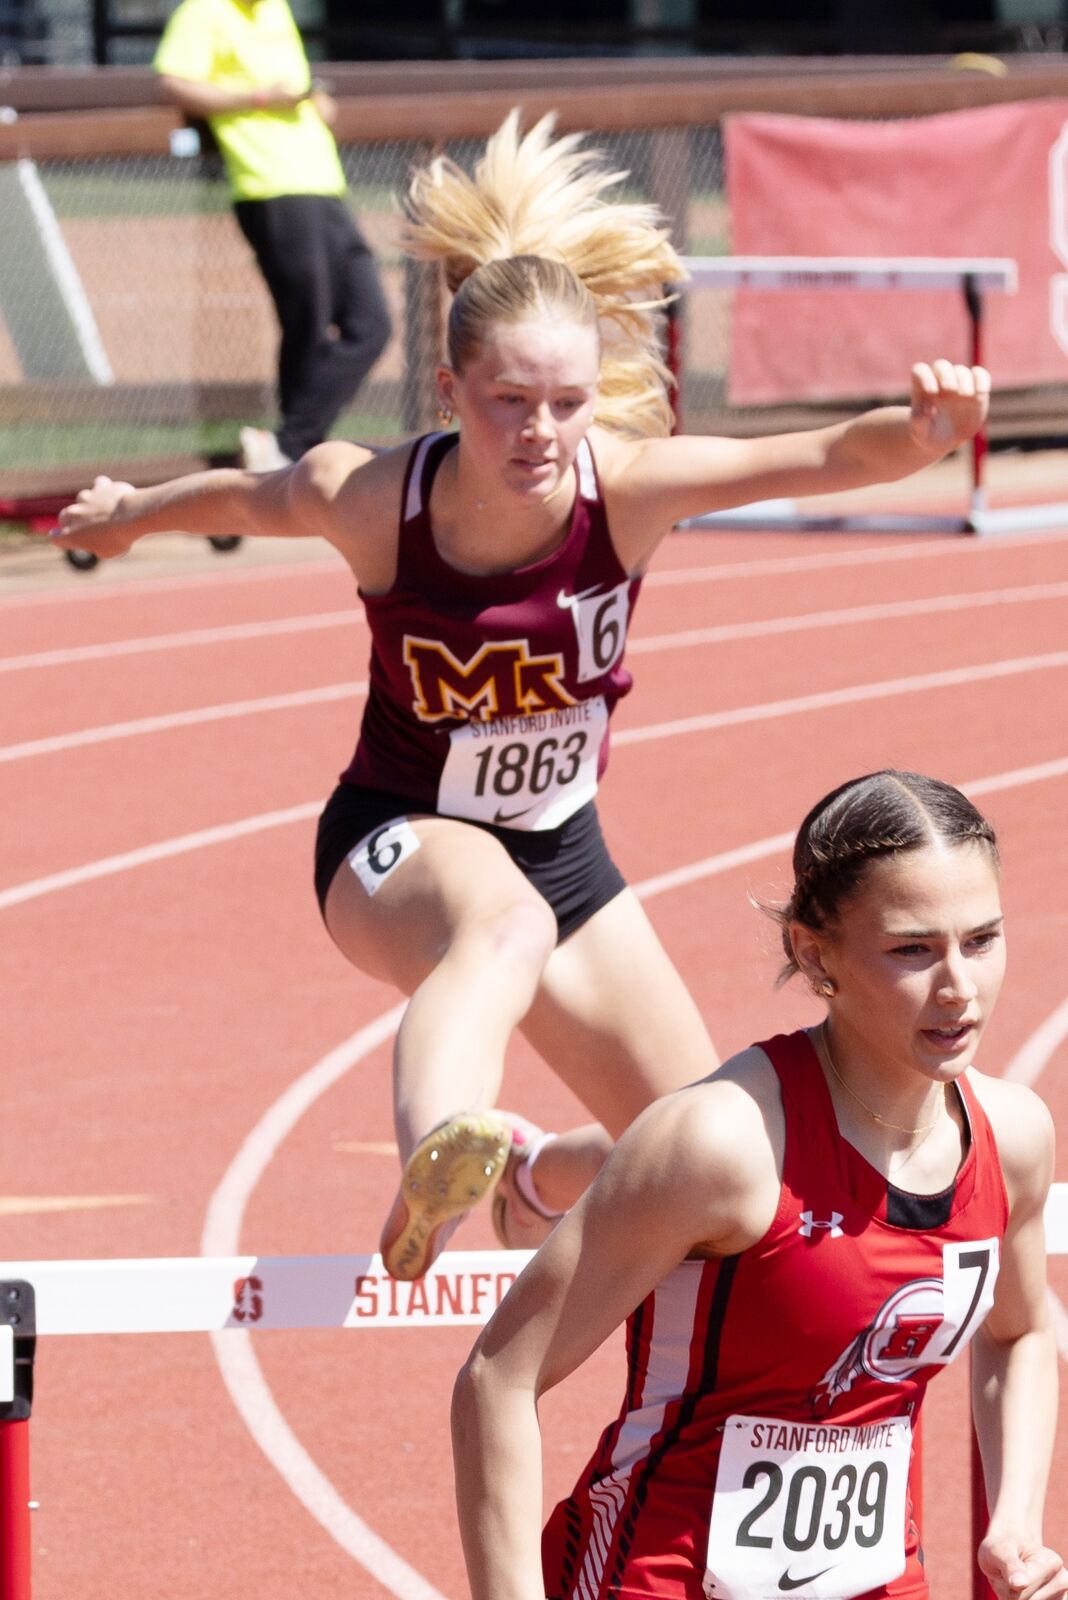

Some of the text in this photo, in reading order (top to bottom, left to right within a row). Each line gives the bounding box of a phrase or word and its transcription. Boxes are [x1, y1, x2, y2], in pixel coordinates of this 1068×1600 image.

[593, 594, 619, 669] 6
[471, 703, 592, 738] STANFORD INVITE
[474, 731, 588, 797] 1863
[367, 827, 402, 875] 6
[940, 1249, 990, 1357] 7
[750, 1423, 894, 1454] STANFORD INVITE
[735, 1460, 889, 1552] 2039
